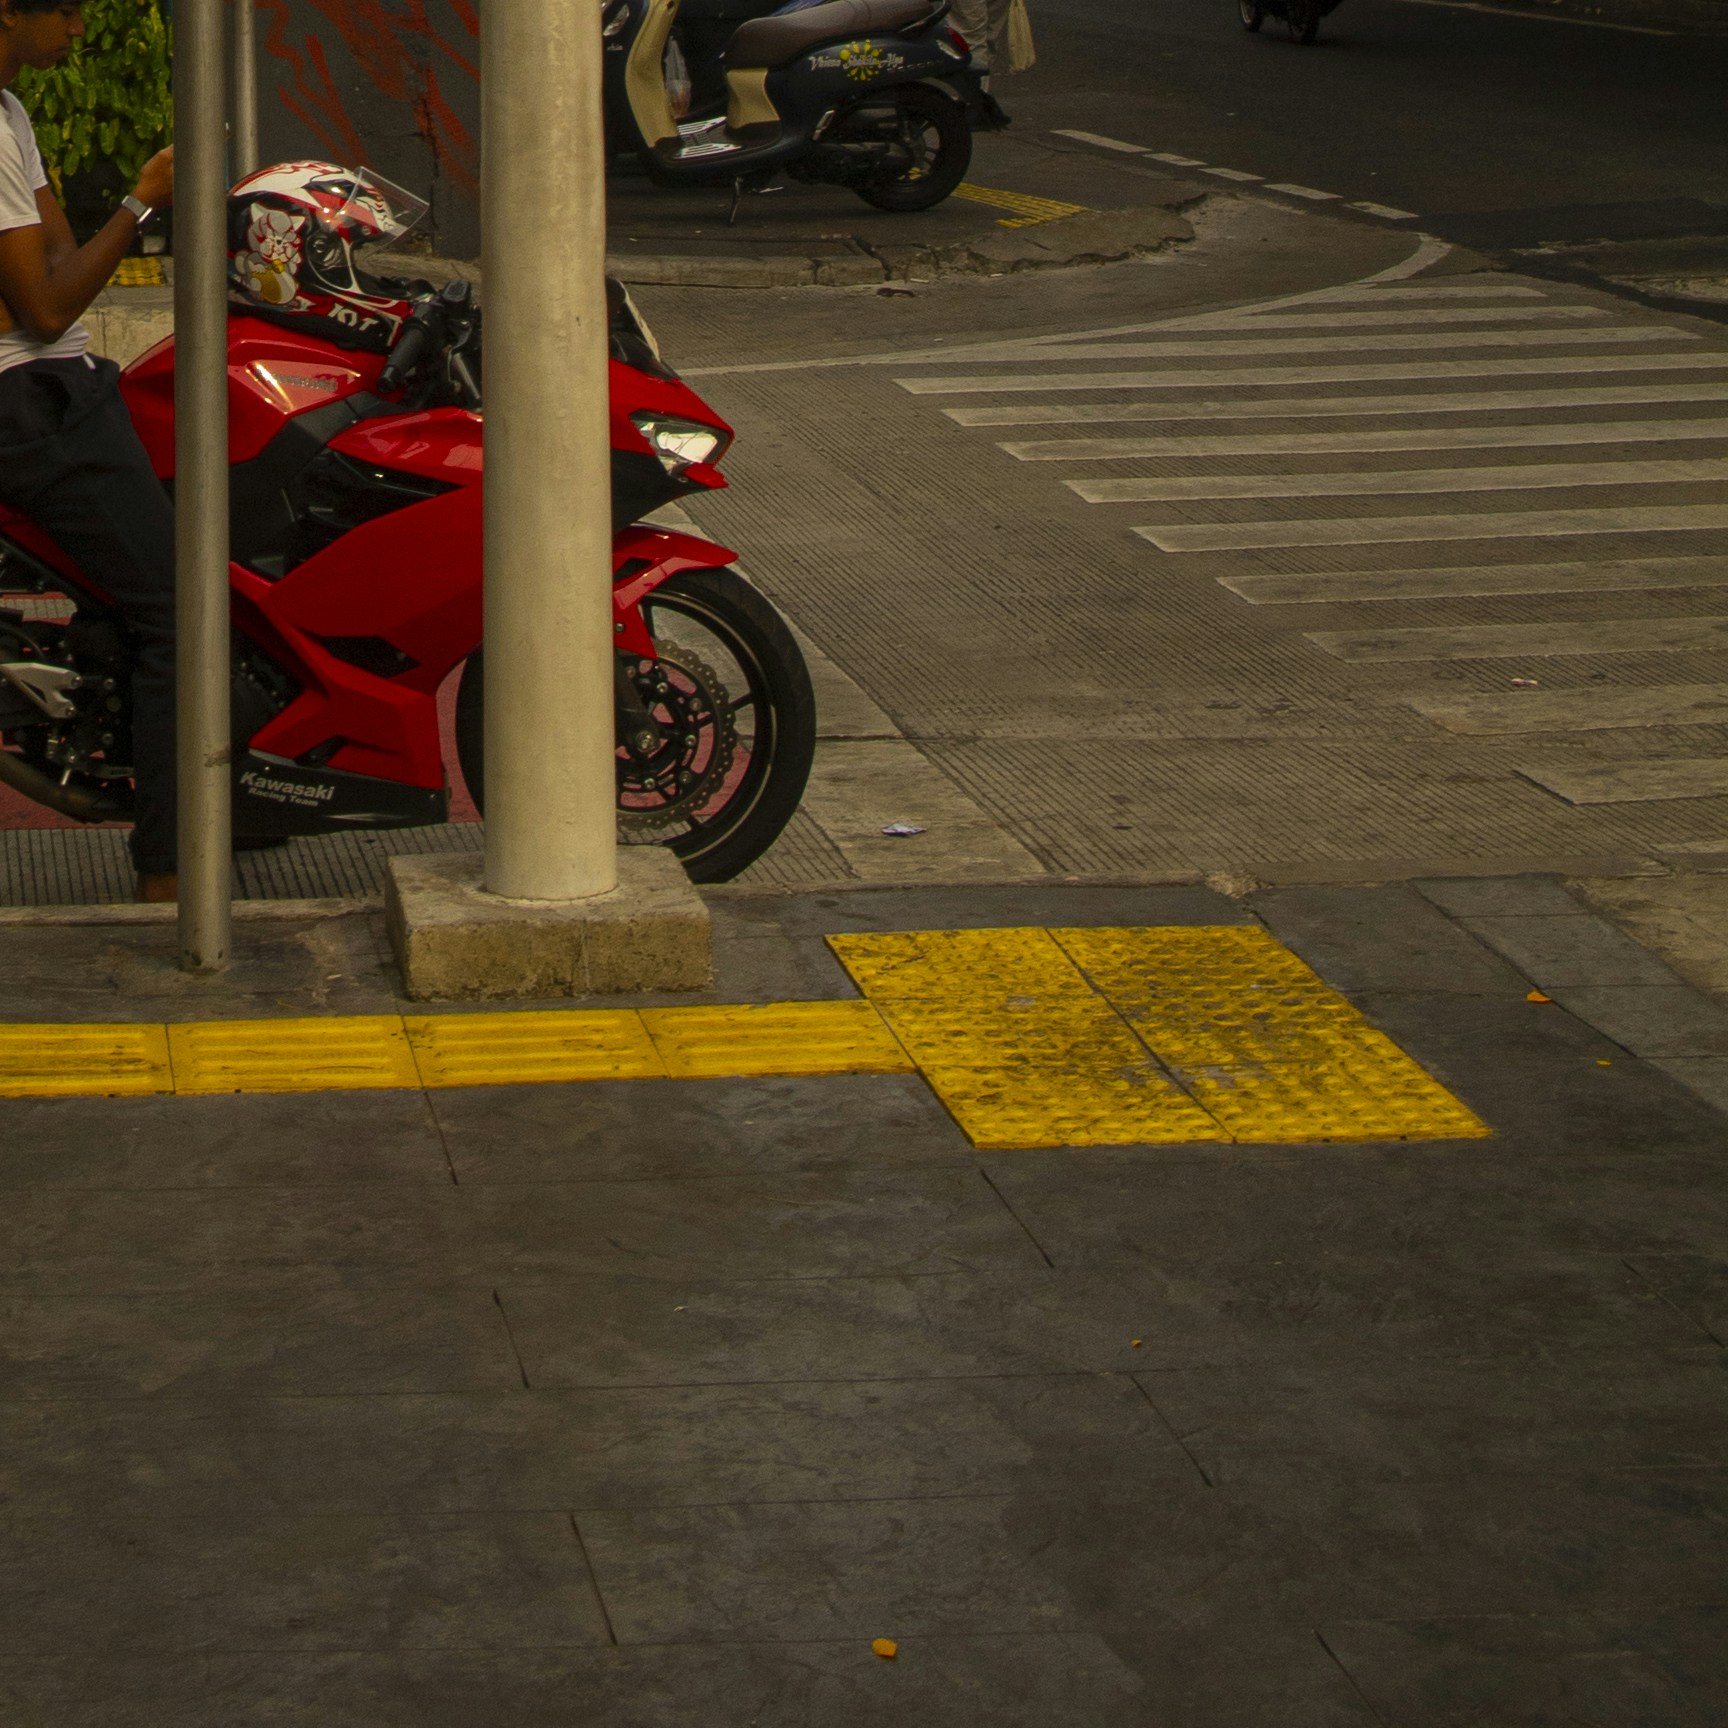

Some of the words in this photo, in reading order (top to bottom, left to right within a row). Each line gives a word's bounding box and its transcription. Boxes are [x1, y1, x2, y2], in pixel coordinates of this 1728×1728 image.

[239, 771, 336, 801] Kawasaki
[247, 786, 288, 803] Racing
[288, 793, 319, 807] Team
